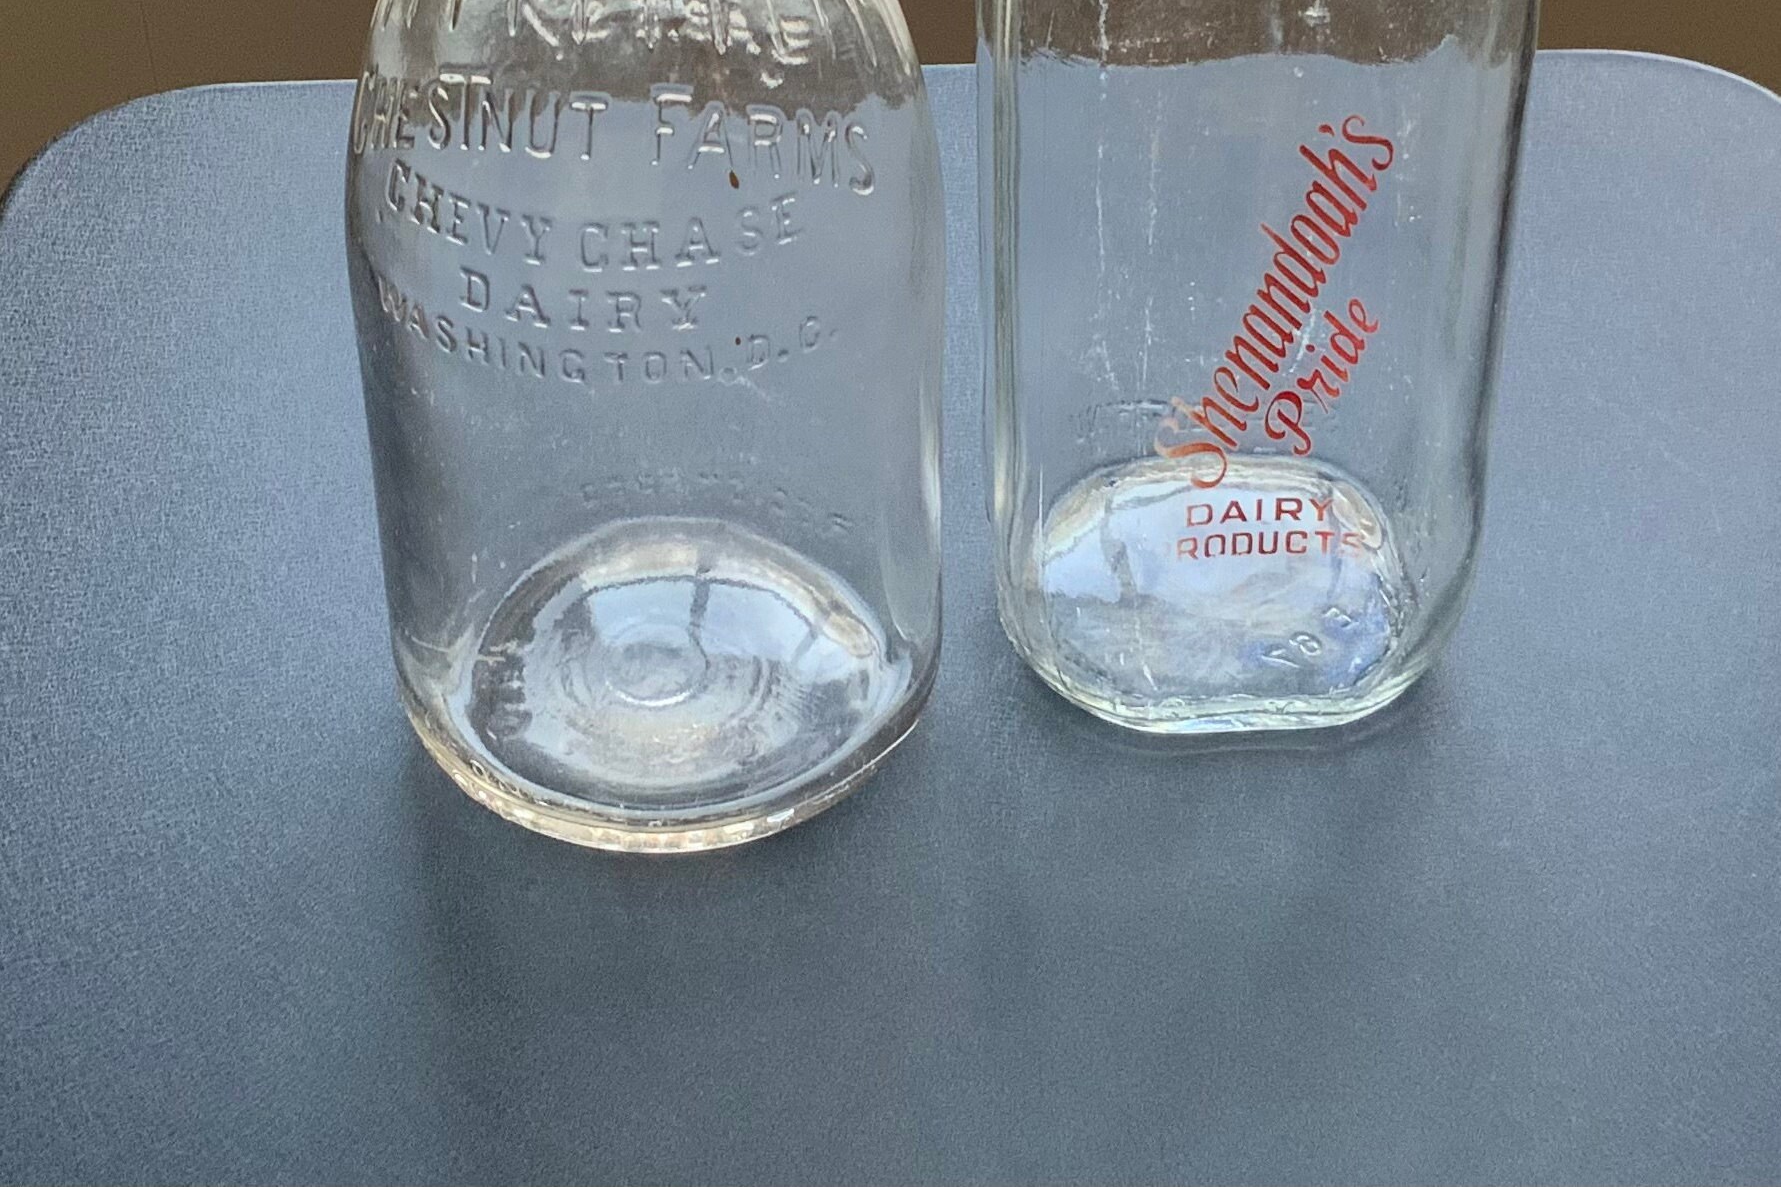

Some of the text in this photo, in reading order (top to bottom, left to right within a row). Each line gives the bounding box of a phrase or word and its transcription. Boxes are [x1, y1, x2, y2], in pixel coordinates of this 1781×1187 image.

[353, 64, 876, 196] CHESTNUT FARMS
[385, 158, 804, 273] CHEVY CHASE
[459, 266, 709, 333] DAIRY
[1155, 115, 1394, 488] Shenandoah's
[1264, 299, 1379, 456] Pride
[1172, 530, 1362, 561] RODUCTS
[1186, 497, 1333, 528] DAIRY
